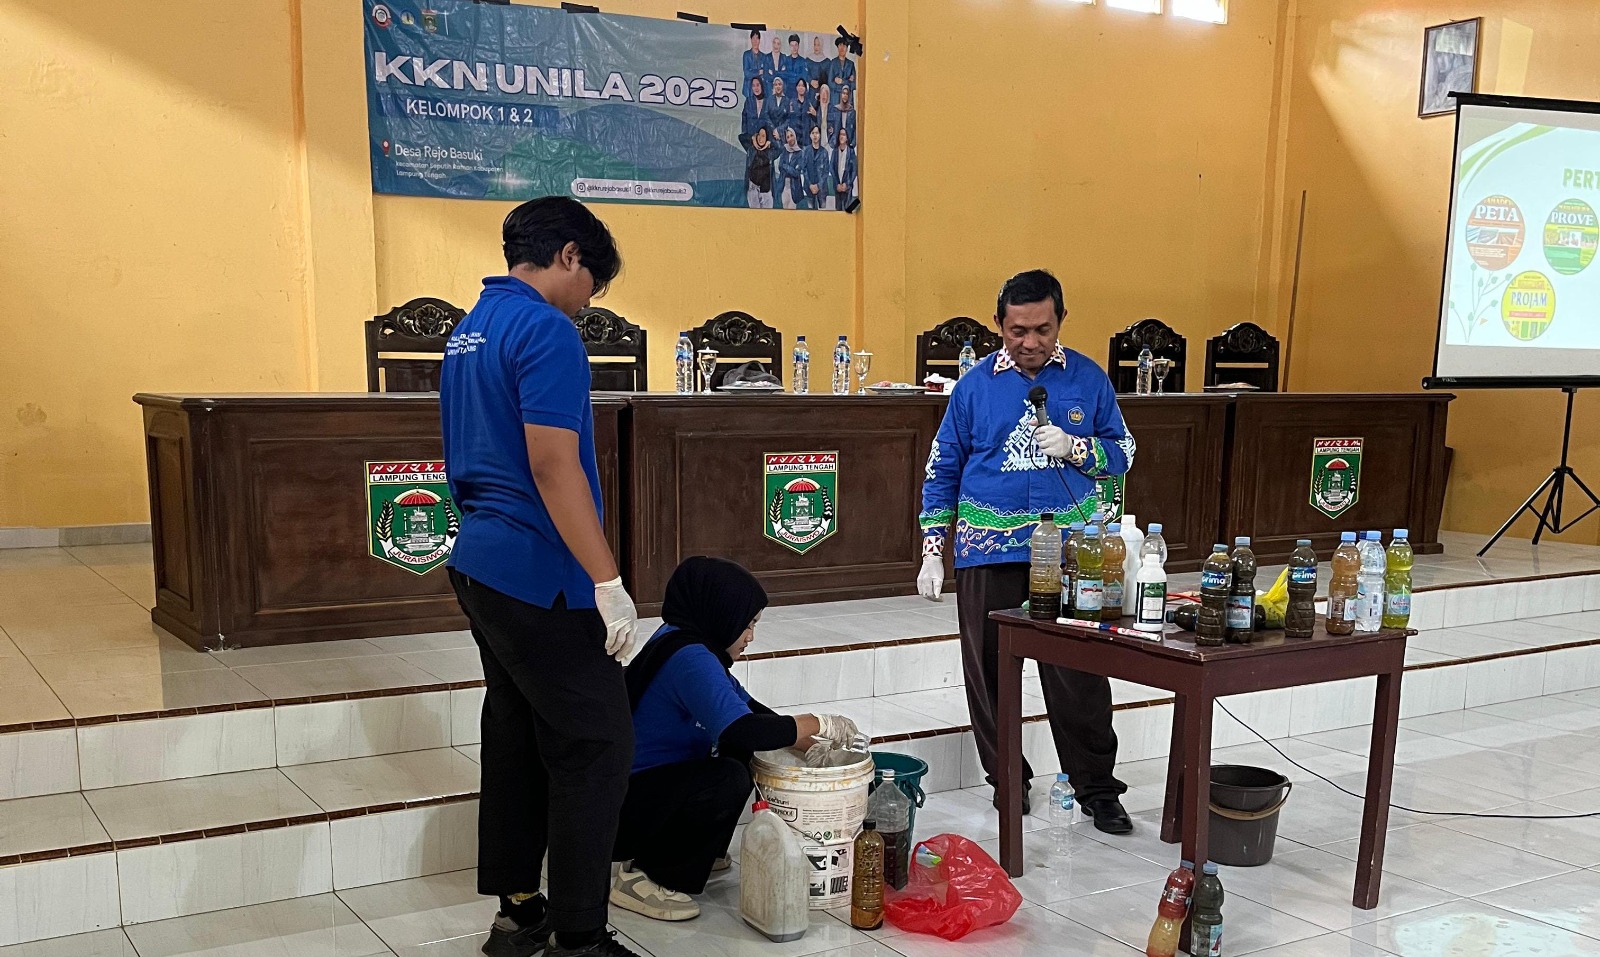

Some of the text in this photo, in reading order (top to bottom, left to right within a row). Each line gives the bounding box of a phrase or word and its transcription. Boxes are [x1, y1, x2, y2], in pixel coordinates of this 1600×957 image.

[374, 51, 739, 109] KKN UNILA 2025
[406, 98, 533, 123] KELOMPOK 1 & 2
[395, 144, 483, 161] Desa Rejo Basuki
[1562, 168, 1600, 190] PERT
[1474, 205, 1520, 222] PETA
[1550, 211, 1594, 226] PROVE
[1511, 291, 1548, 309] PROJAM
[373, 473, 446, 482] LAMPUNG TENG
